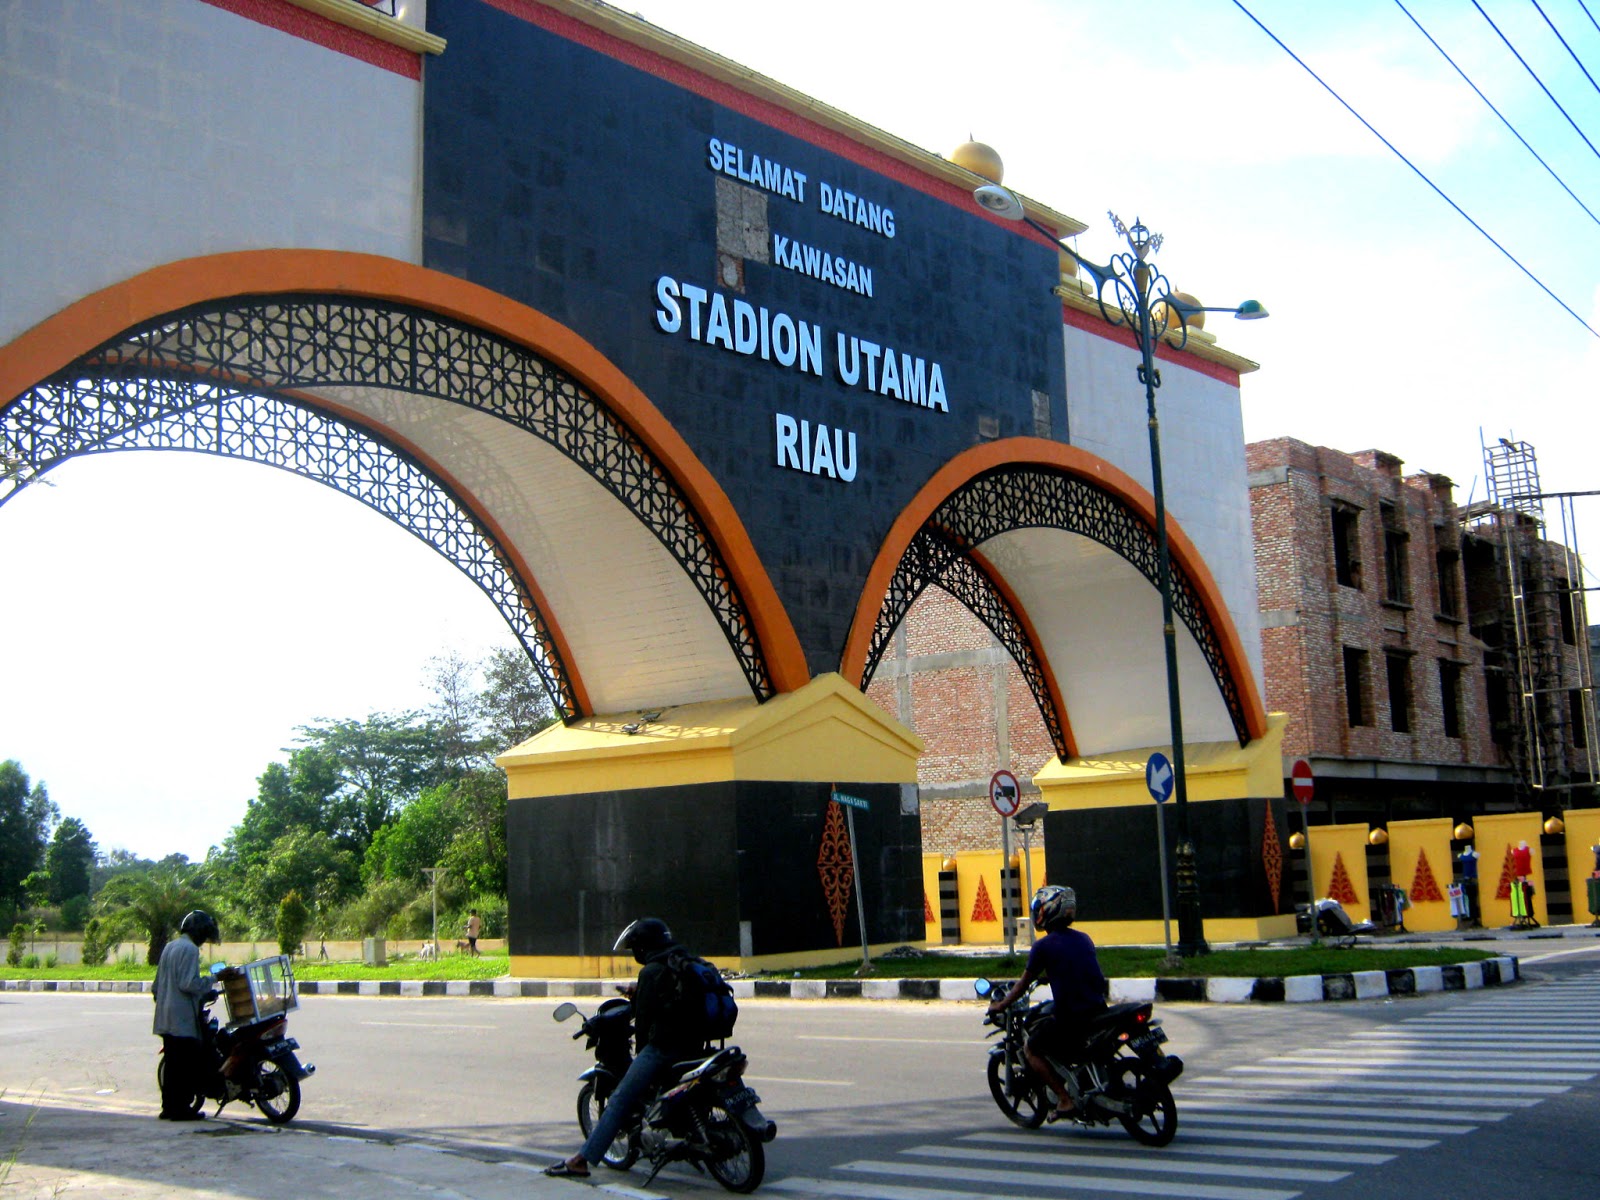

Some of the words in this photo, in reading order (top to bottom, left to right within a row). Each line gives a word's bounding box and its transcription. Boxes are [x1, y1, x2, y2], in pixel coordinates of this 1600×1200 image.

[709, 138, 807, 203] SELAMAT
[820, 181, 896, 239] DATANG
[774, 234, 873, 298] KAWASAN
[656, 275, 823, 377] STADION
[837, 332, 950, 413] UTAMA
[775, 413, 858, 483] RIAU
